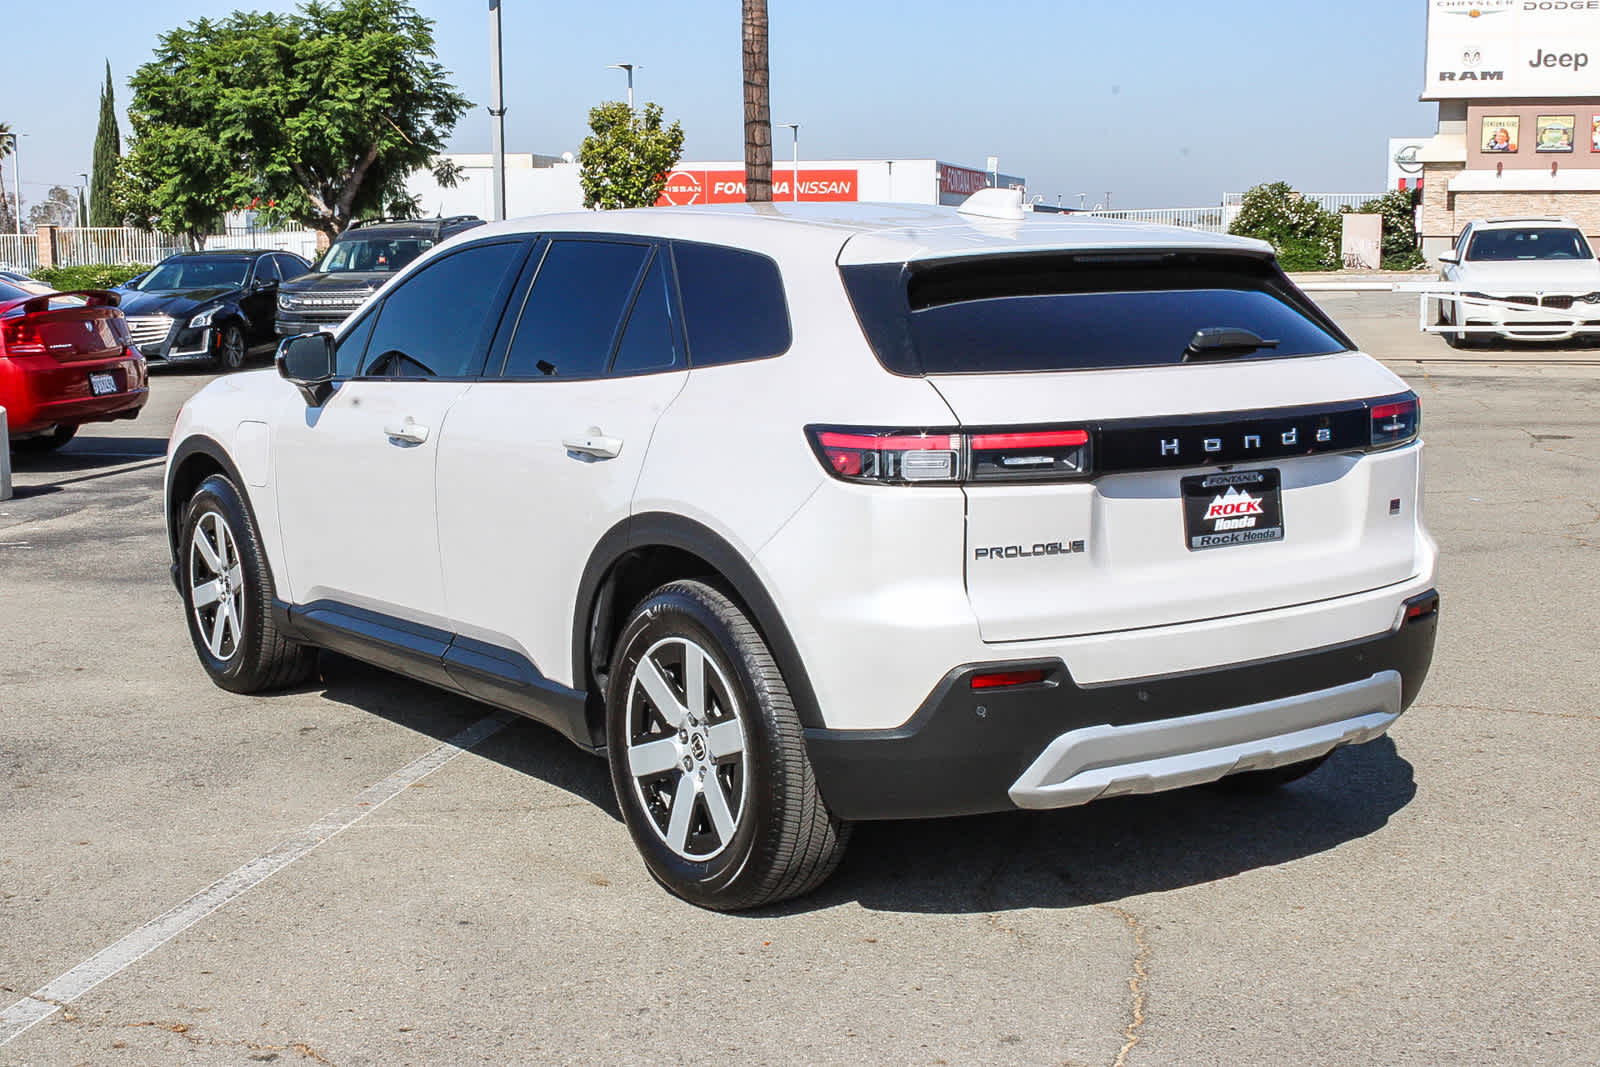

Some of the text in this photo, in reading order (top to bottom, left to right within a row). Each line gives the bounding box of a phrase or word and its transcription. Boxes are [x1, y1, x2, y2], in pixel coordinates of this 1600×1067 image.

[1523, 1, 1599, 10] DODGE
[1529, 49, 1588, 71] Jeep
[1438, 71, 1504, 81] RAM
[714, 181, 851, 194] FONNA NISSAN
[1210, 501, 1258, 516] ROCK
[1214, 516, 1256, 531] Honda
[1201, 529, 1275, 545] Rock Honda
[975, 539, 1084, 560] PROLOGUE
